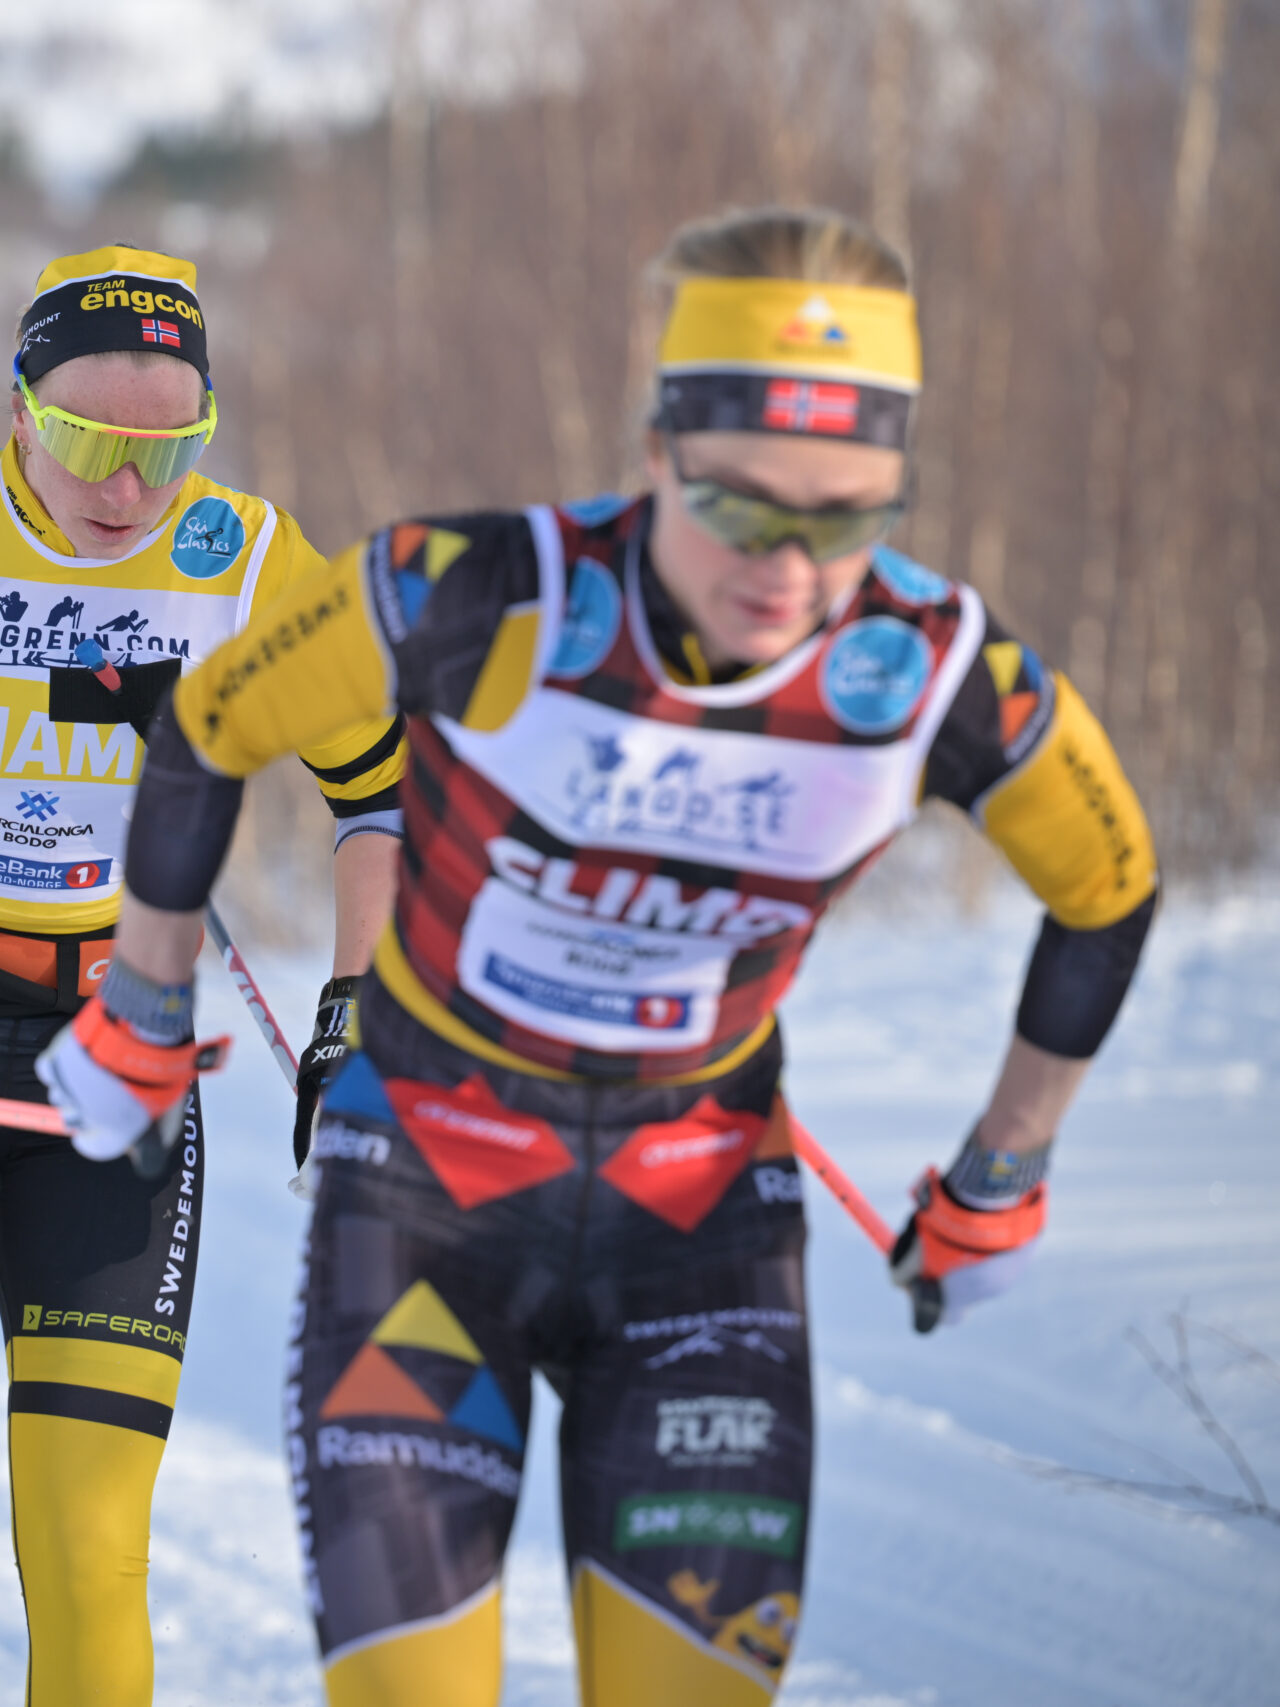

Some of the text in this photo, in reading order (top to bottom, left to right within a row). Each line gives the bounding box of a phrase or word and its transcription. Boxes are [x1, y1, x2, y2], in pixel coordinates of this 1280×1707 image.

[87, 279, 126, 293] TEAM
[79, 289, 204, 330] engcon
[3, 831, 57, 849] BODØ
[76, 866, 90, 884] 1
[155, 1078, 198, 1316] SWEDEMOUN
